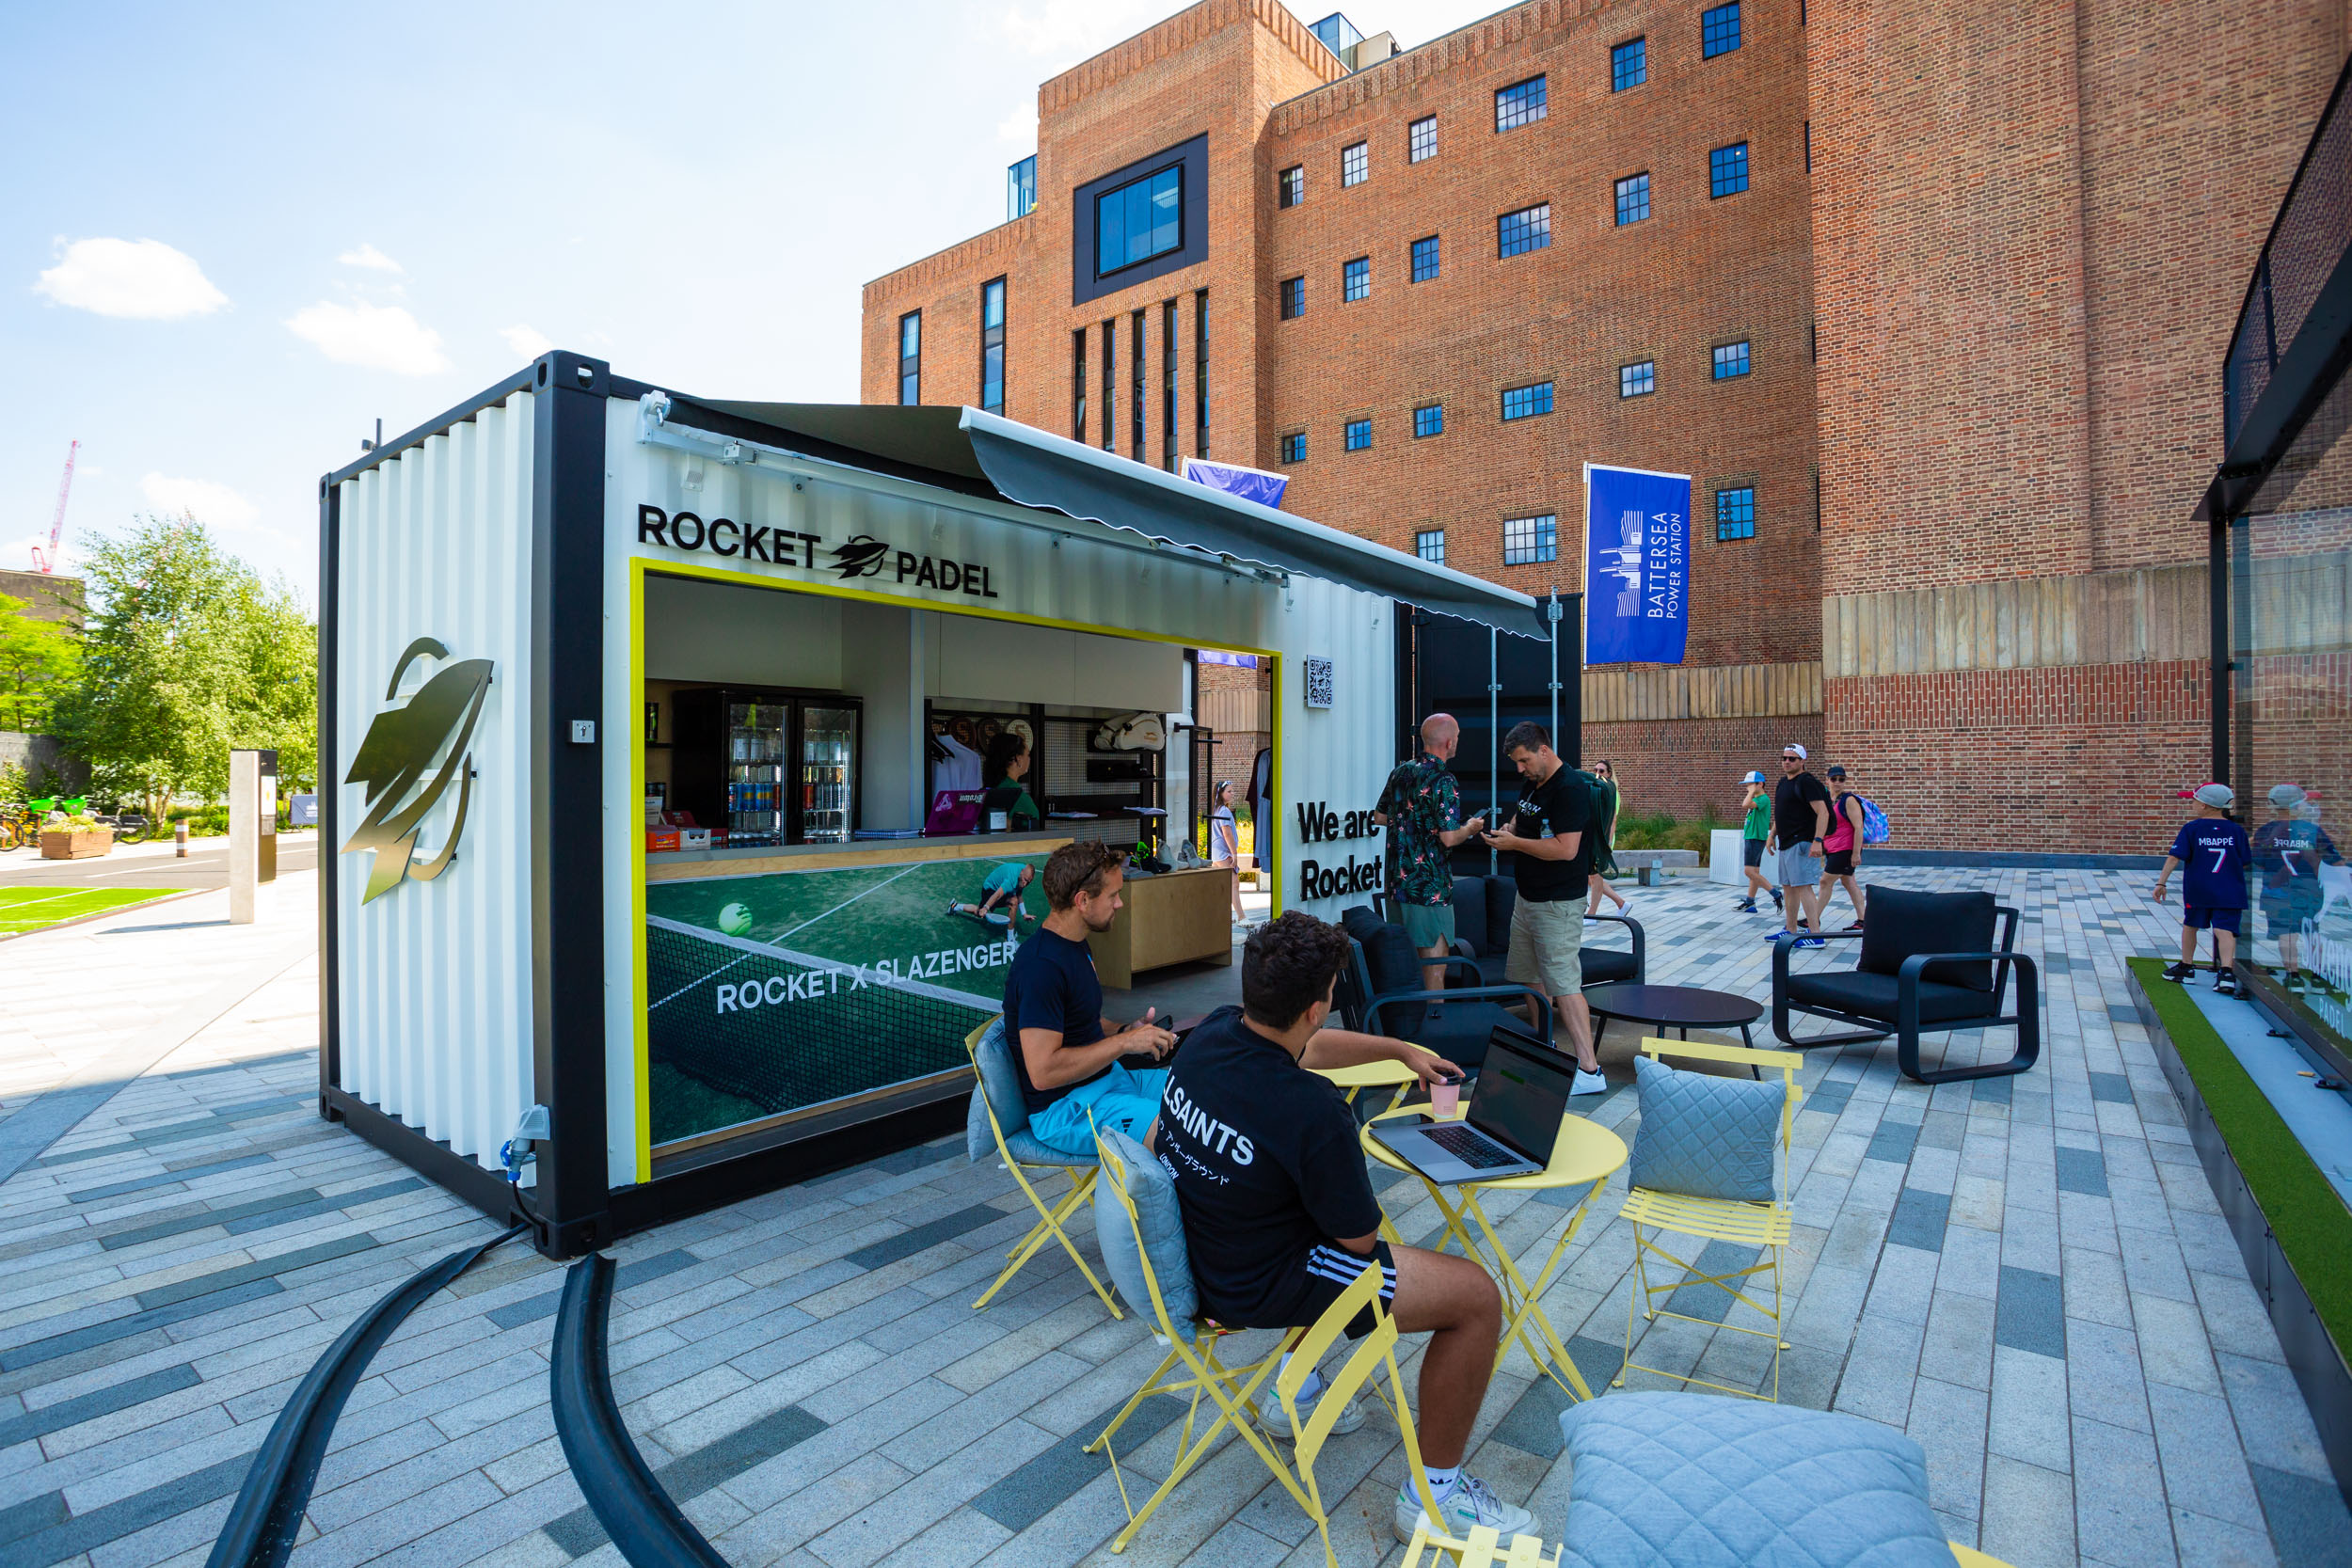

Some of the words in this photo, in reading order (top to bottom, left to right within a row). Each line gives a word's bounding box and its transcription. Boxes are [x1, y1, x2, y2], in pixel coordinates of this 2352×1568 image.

[638, 503, 821, 569] ROCKET
[897, 551, 998, 598] PADEL
[1670, 514, 1682, 564] STATION
[1647, 512, 1668, 618] BATTERSEA
[1666, 571, 1681, 619] POWER
[1296, 801, 1339, 844] We
[1343, 809, 1380, 839] are
[2198, 836, 2234, 847] MBAPPÉ
[1301, 854, 1383, 901] Rocket
[2208, 848, 2227, 873] 7
[717, 968, 842, 1014] ROCKET
[850, 962, 868, 990] X
[875, 941, 1016, 986] SLAZENGER
[2319, 997, 2346, 1038] PADEL
[1164, 1066, 1254, 1165] LSAINTS
[1159, 1152, 1180, 1180] LONDON
